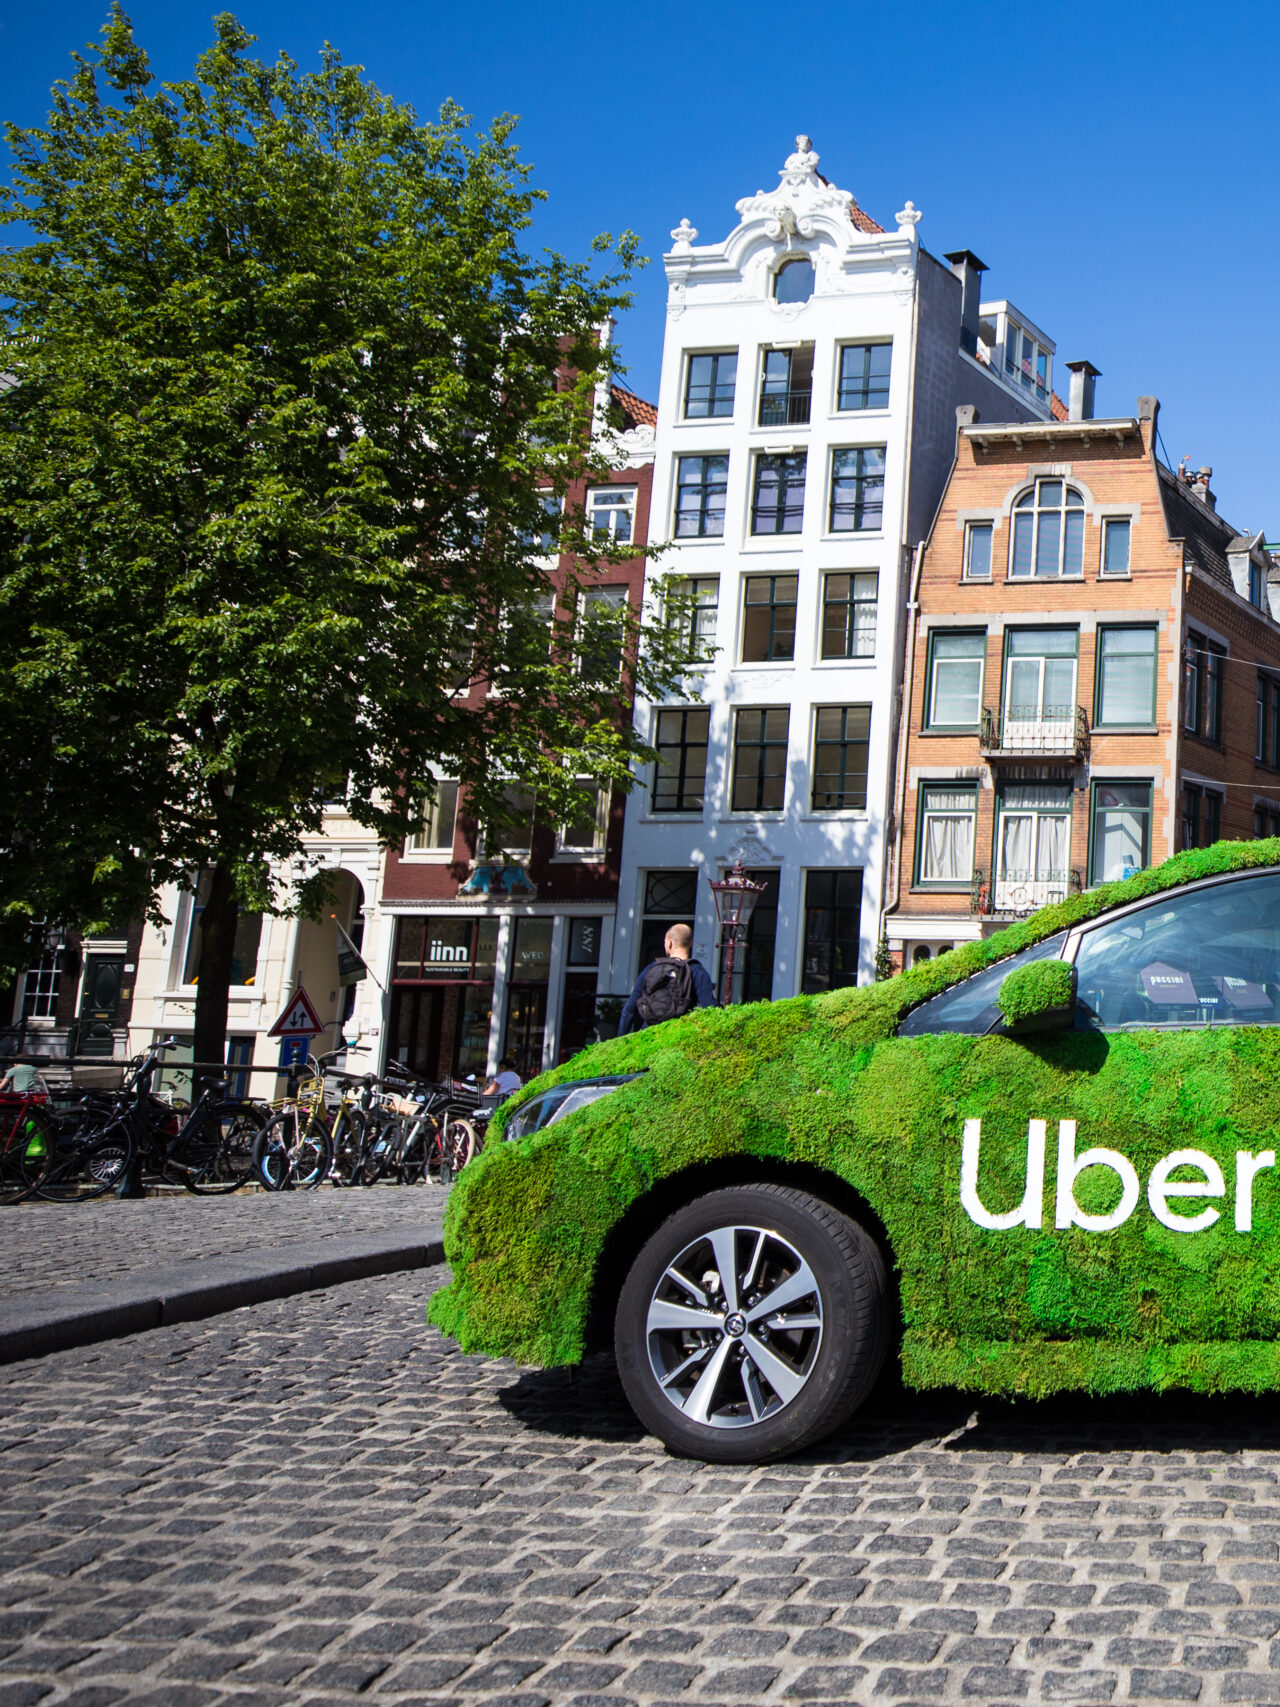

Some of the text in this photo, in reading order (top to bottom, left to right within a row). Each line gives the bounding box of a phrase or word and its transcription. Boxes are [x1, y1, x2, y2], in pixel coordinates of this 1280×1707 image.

[430, 940, 468, 961] iinn
[521, 951, 549, 960] AVED
[958, 1118, 1277, 1233] Uber
